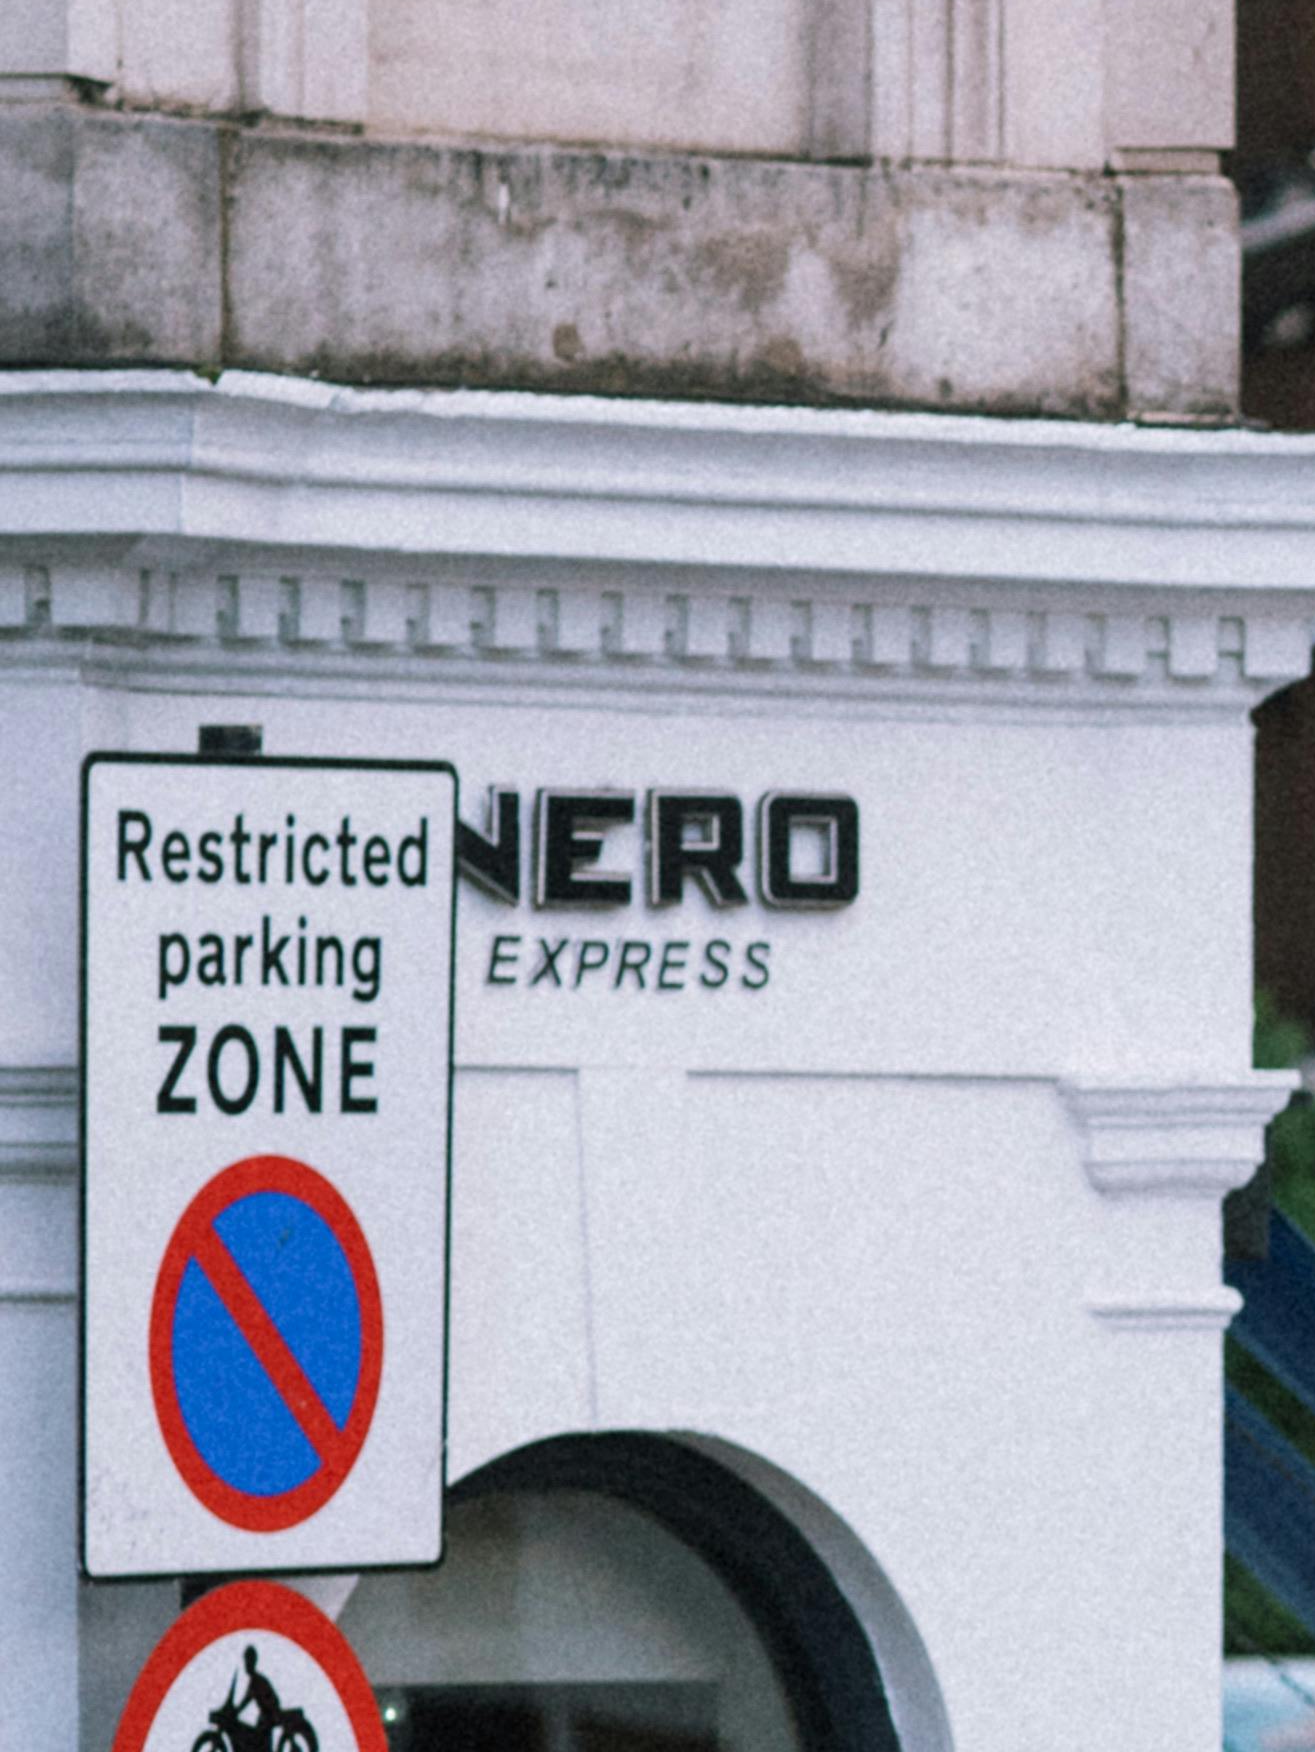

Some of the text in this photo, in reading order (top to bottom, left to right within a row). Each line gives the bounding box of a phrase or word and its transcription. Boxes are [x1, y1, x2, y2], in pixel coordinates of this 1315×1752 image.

[117, 809, 428, 887] Restricted
[457, 785, 859, 908] NERO
[158, 914, 382, 1002] parking
[486, 934, 771, 991] EXPRESS
[156, 1023, 378, 1116] ZONE
